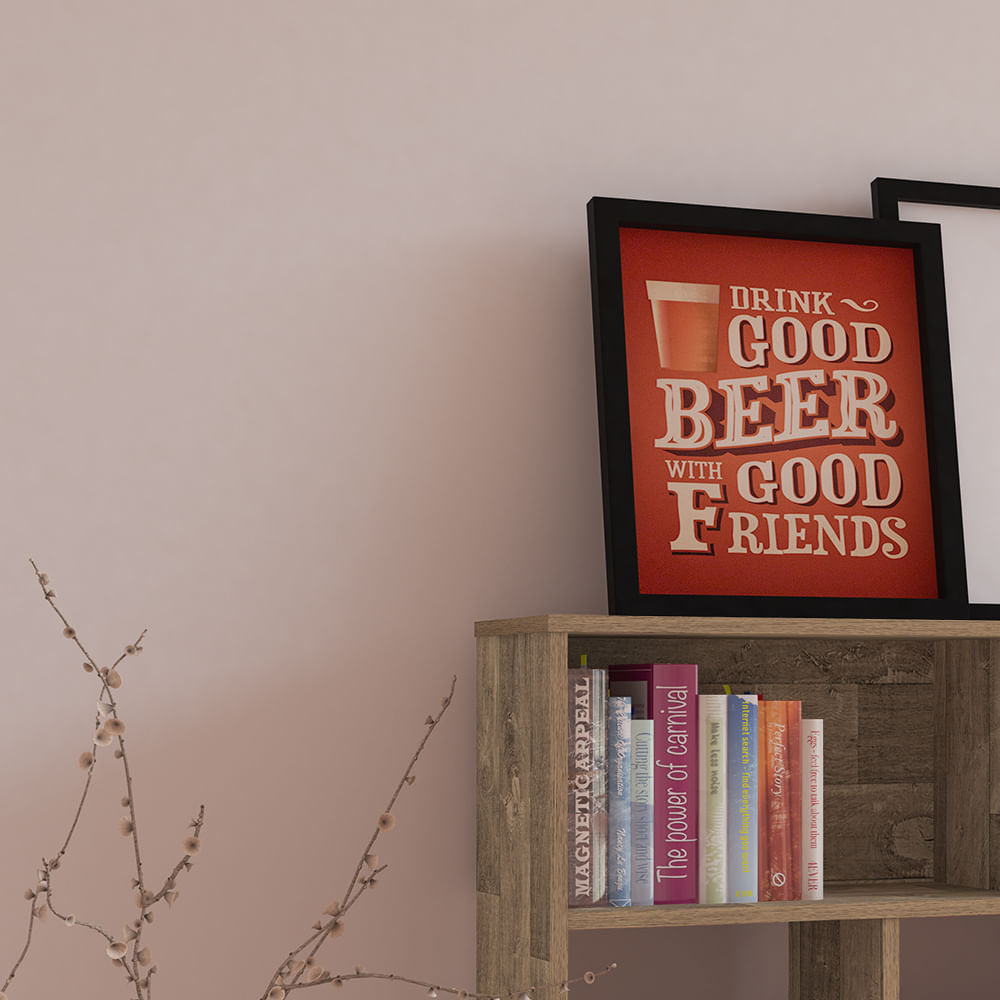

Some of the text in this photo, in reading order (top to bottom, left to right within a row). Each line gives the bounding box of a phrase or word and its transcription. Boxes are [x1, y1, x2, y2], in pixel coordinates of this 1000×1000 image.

[729, 286, 835, 315] DRINK
[728, 314, 893, 369] GOOD
[654, 369, 902, 452] BEER
[665, 453, 903, 507] WITH GOOD
[667, 482, 909, 559] FRIENDS
[710, 722, 721, 745] Make
[710, 749, 721, 767] less
[771, 722, 787, 762] Perfect
[807, 730, 820, 749] Eggs
[575, 677, 590, 897] MAGNETIC ARPEAL
[632, 732, 652, 885] Cutting the story short and wise
[656, 685, 698, 883] The power of carnival
[739, 701, 751, 873] Internet search find everything you want
[770, 766, 786, 797] Story
